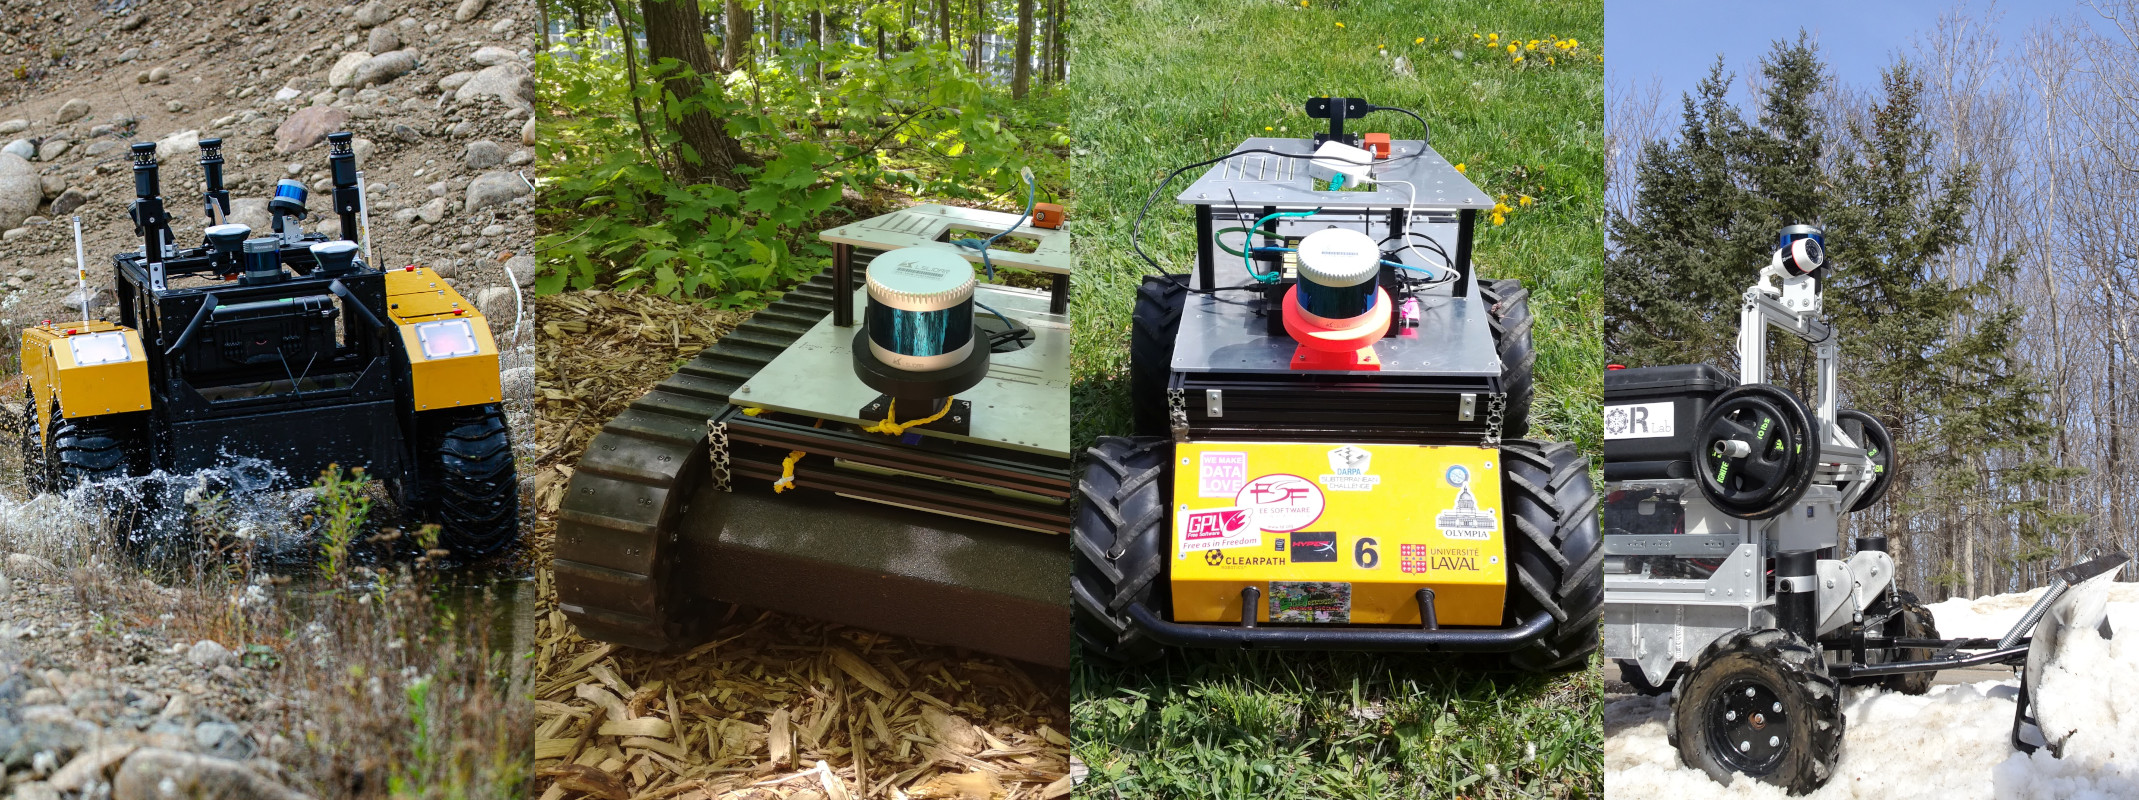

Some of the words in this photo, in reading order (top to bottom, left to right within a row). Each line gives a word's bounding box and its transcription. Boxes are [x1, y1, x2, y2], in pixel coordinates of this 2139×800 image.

[1651, 419, 1672, 433] Lab
[1204, 456, 1217, 464] WE
[1218, 456, 1243, 464] MAKE
[1203, 465, 1242, 478] DATA
[1337, 468, 1361, 476] DARPA
[1716, 461, 1729, 484] IGNITE
[1202, 479, 1242, 492] LOVE
[1445, 530, 1488, 538] OLYMPIA
[1182, 542, 1200, 550] Free
[1212, 539, 1220, 547] in
[1222, 537, 1257, 546] Freedom
[1355, 537, 1378, 568] 6
[1430, 547, 1479, 557] UNIVERSITÉ
[1225, 557, 1286, 566] CLEARPATH
[1431, 556, 1479, 571] LAVAL
